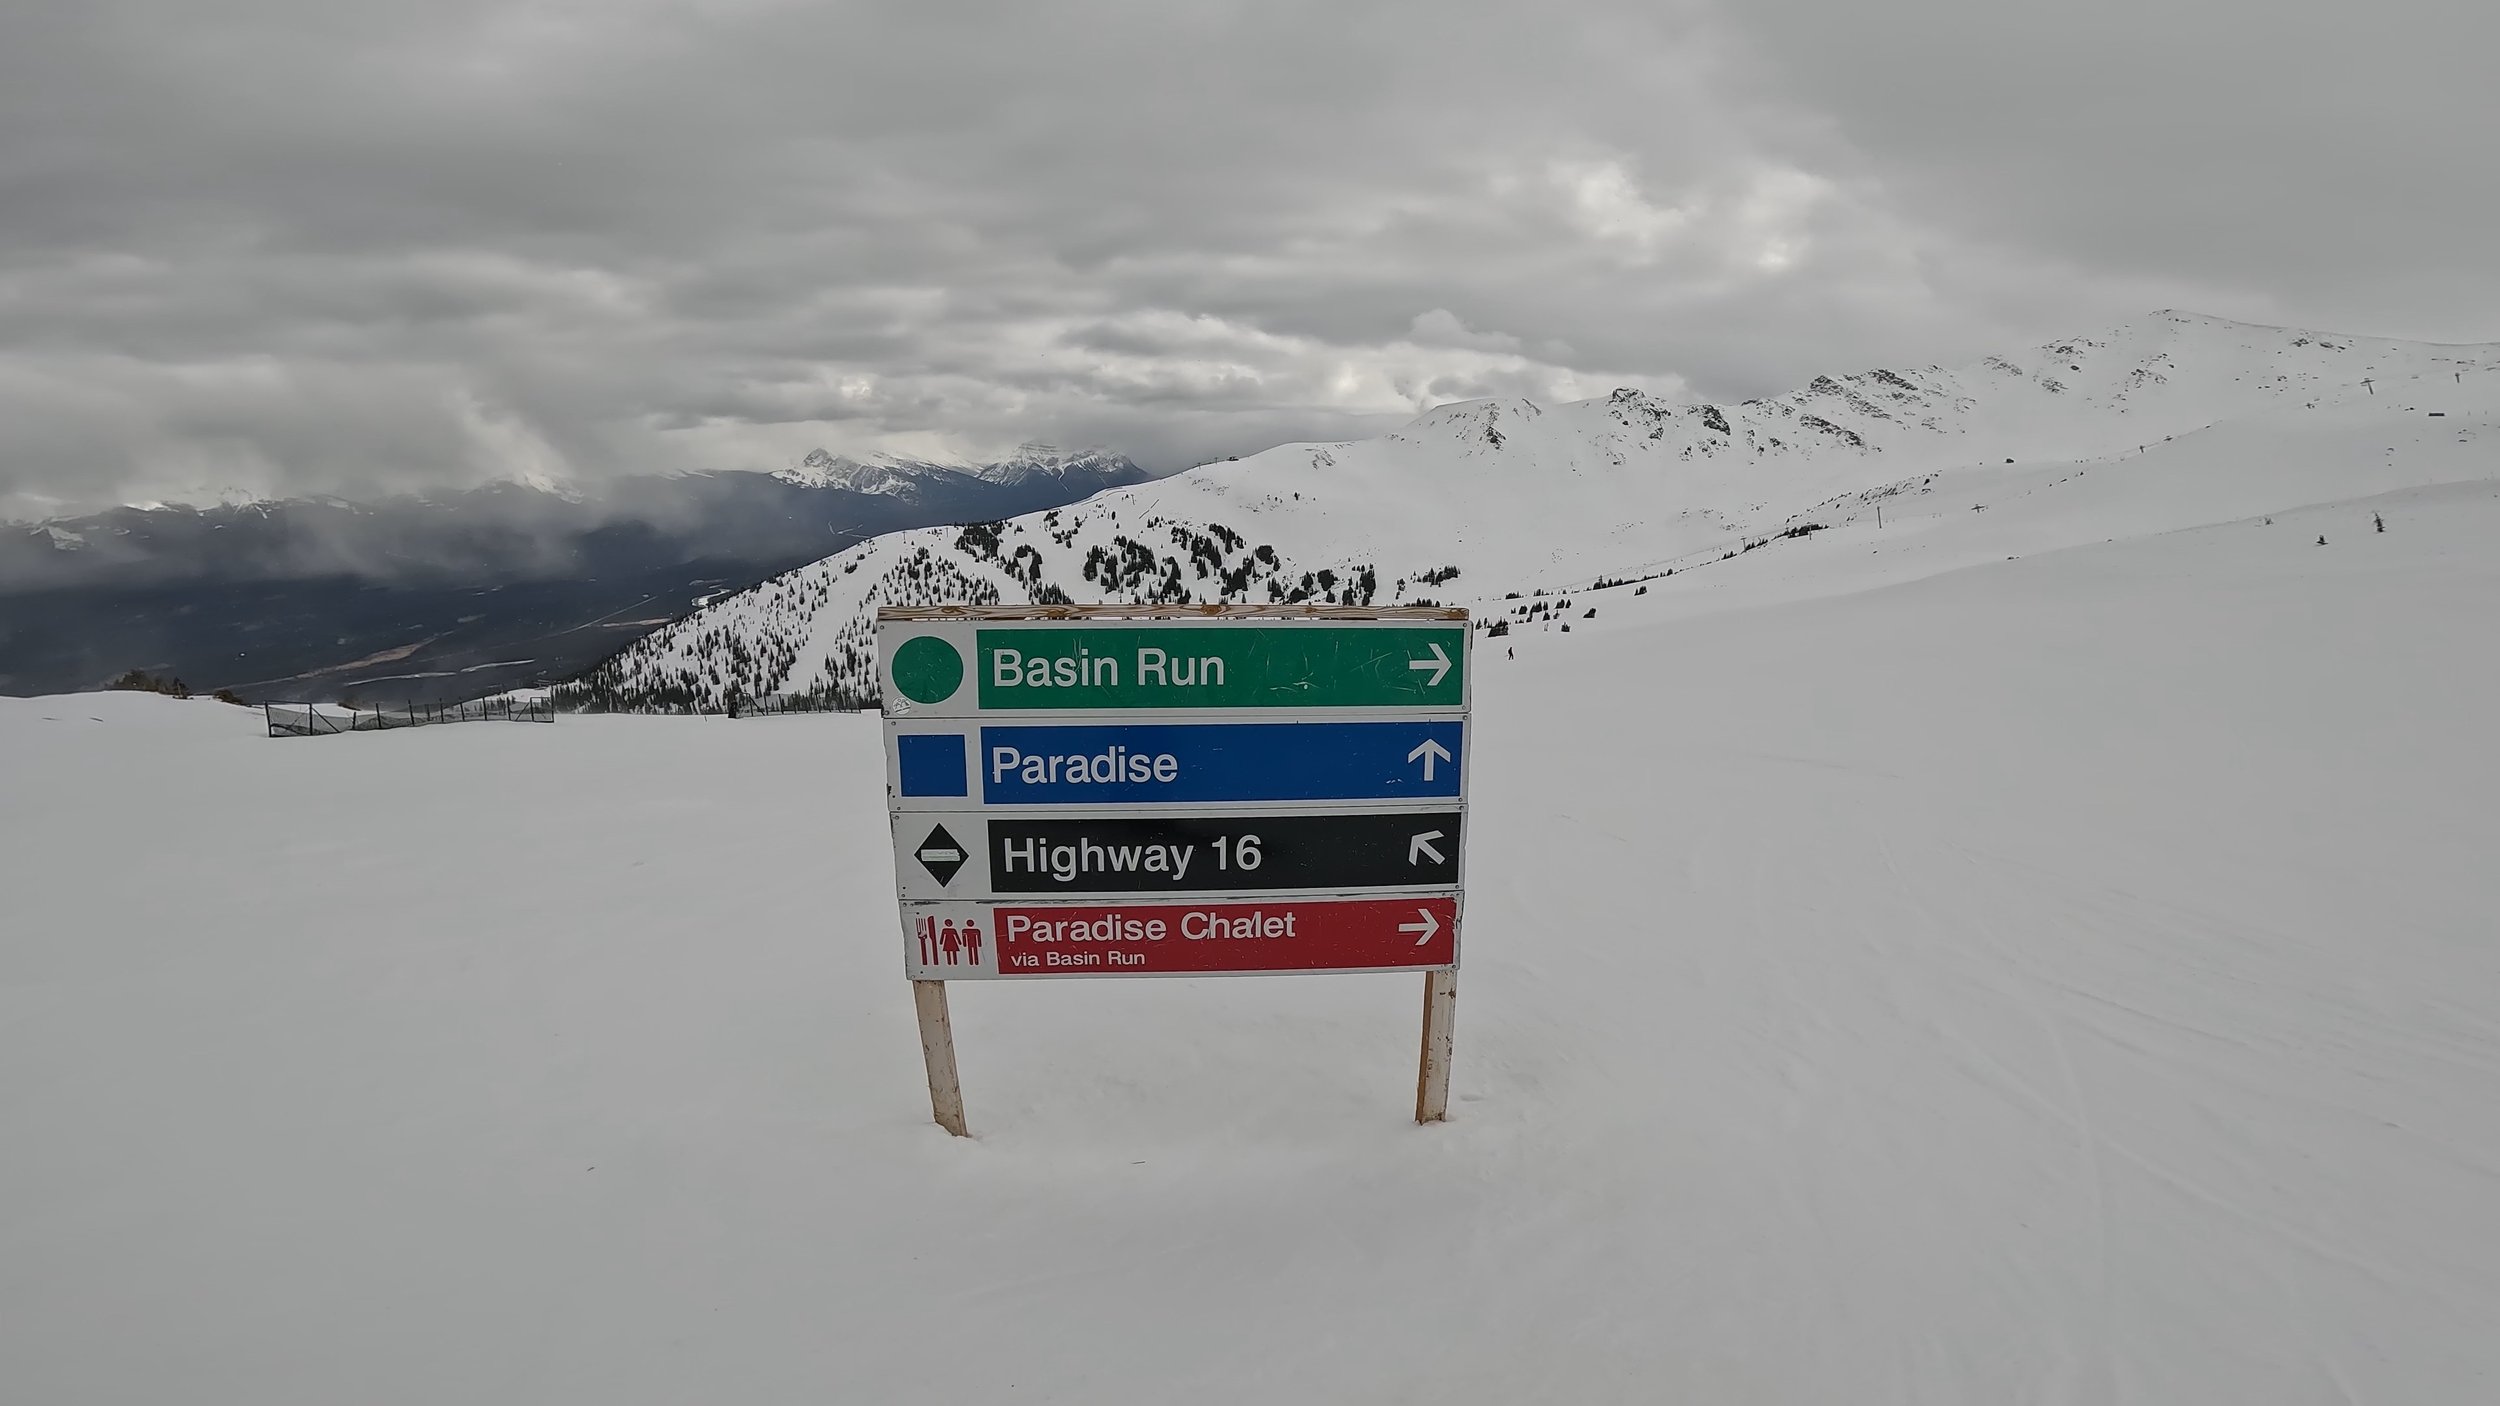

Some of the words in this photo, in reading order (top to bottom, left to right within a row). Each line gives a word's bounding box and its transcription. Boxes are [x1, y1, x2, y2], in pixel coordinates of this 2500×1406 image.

[993, 648, 1118, 688] Basin
[1137, 647, 1225, 686] Run
[992, 745, 1178, 784] Paradise
[1004, 837, 1195, 882] Highway
[1211, 834, 1262, 871] 16
[1006, 913, 1167, 943] Paradise
[1180, 910, 1296, 940] Chalet
[1010, 952, 1040, 967] via
[1046, 950, 1100, 966] Basin
[1107, 950, 1146, 965] Run
